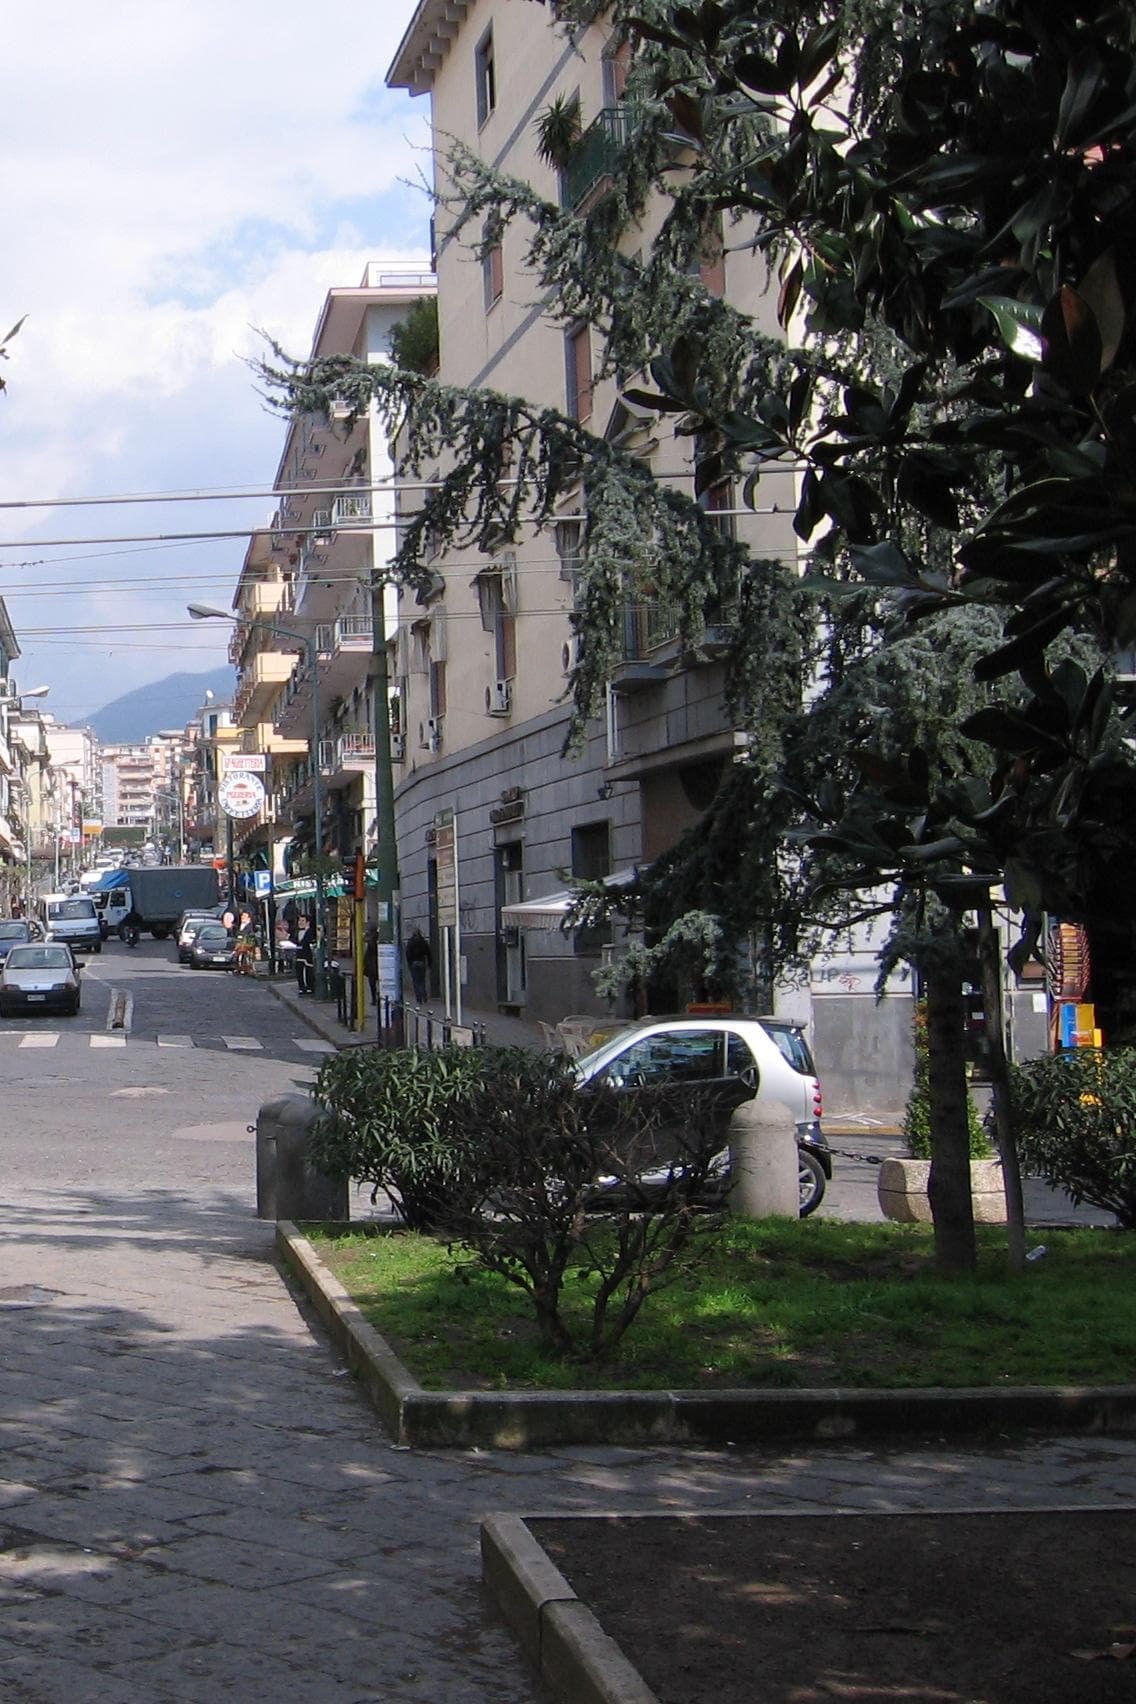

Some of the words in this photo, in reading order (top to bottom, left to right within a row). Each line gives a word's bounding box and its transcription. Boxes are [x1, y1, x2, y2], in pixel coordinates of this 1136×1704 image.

[219, 772, 262, 793] RISTORANTE
[226, 791, 256, 799] PIZZERIA
[259, 873, 270, 889] P
